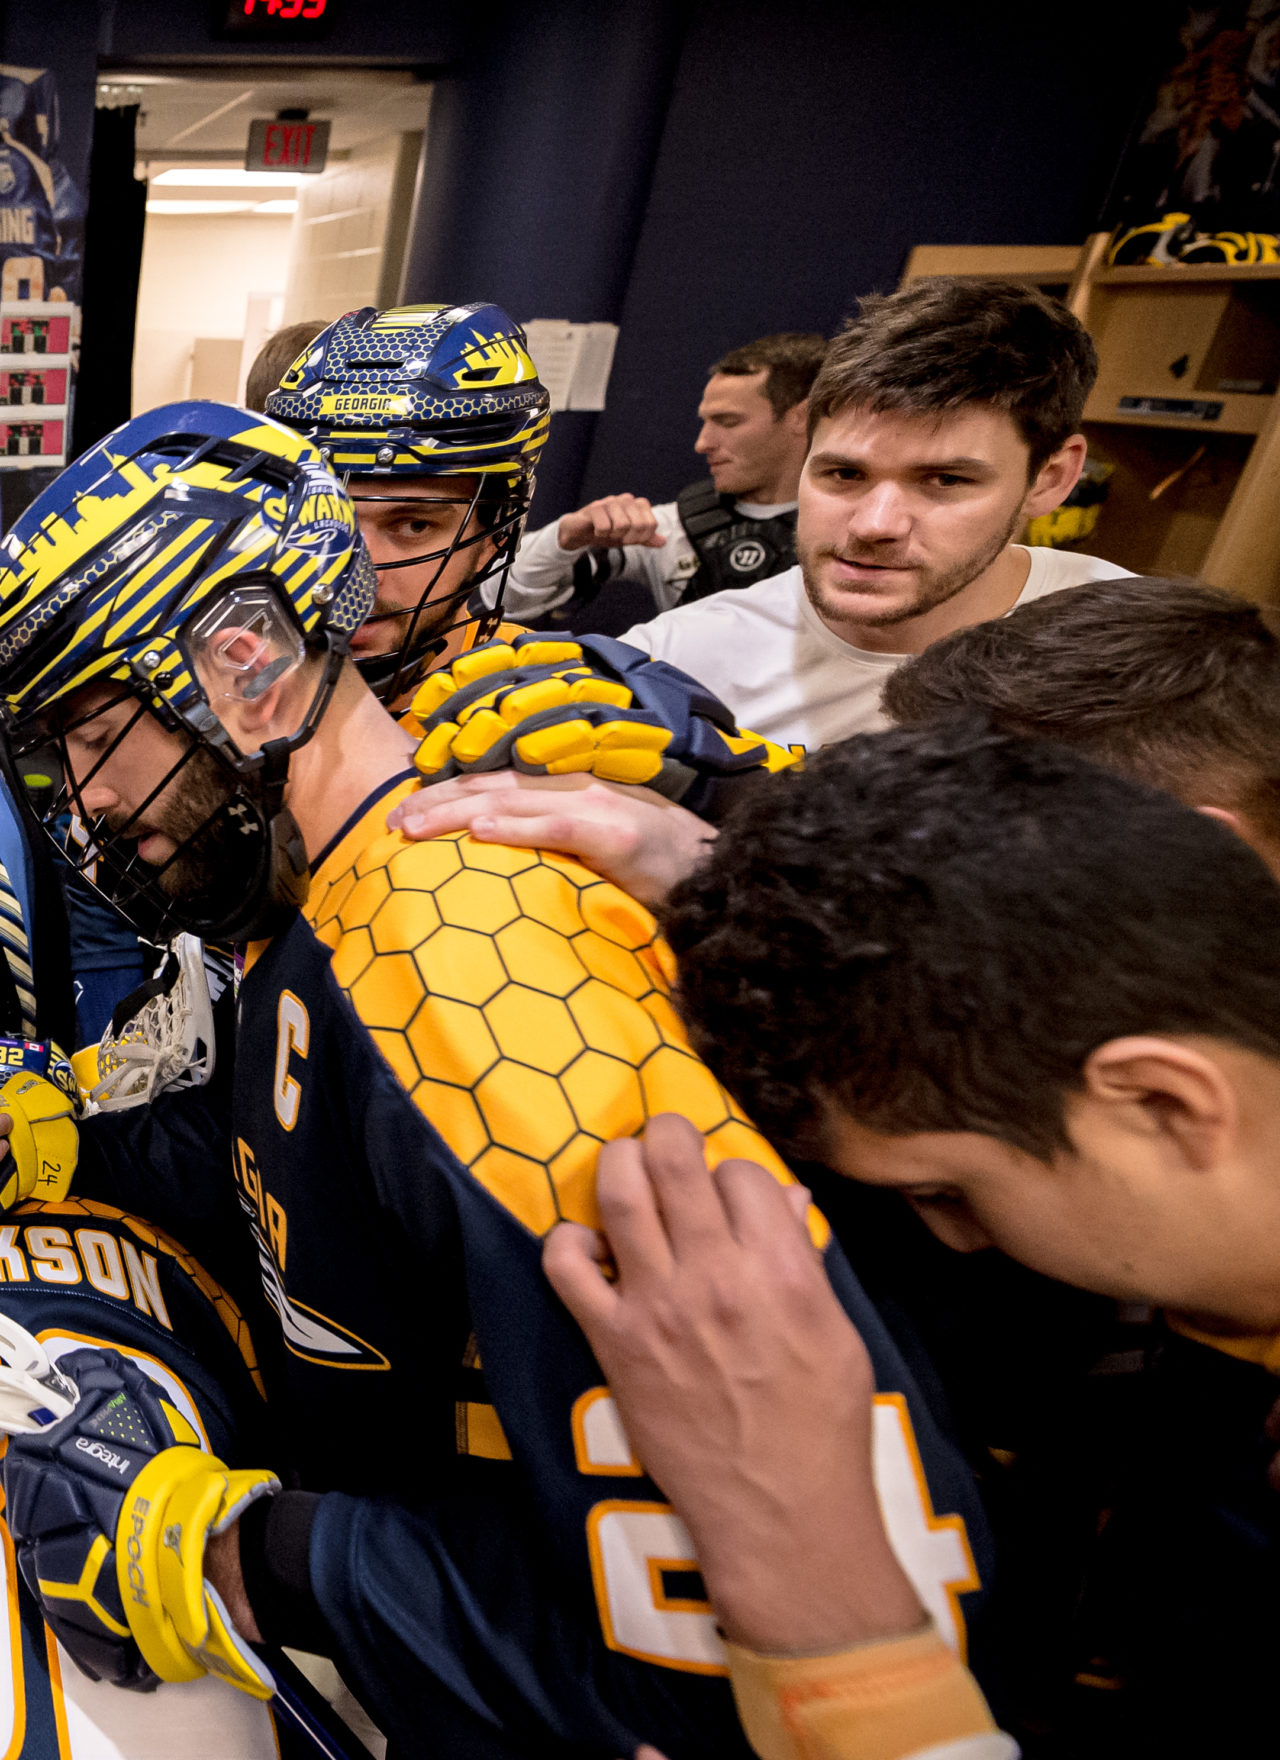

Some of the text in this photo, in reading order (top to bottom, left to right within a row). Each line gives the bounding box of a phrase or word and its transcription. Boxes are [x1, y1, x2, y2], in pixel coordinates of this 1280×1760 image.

[262, 123, 317, 167] EXIT
[334, 397, 392, 411] GEORGIA
[273, 988, 311, 1133] C
[37, 1159, 62, 1188] 24
[232, 1136, 288, 1273] GIA
[75, 1436, 131, 1475] Integra
[126, 1495, 152, 1609] EPOCH
